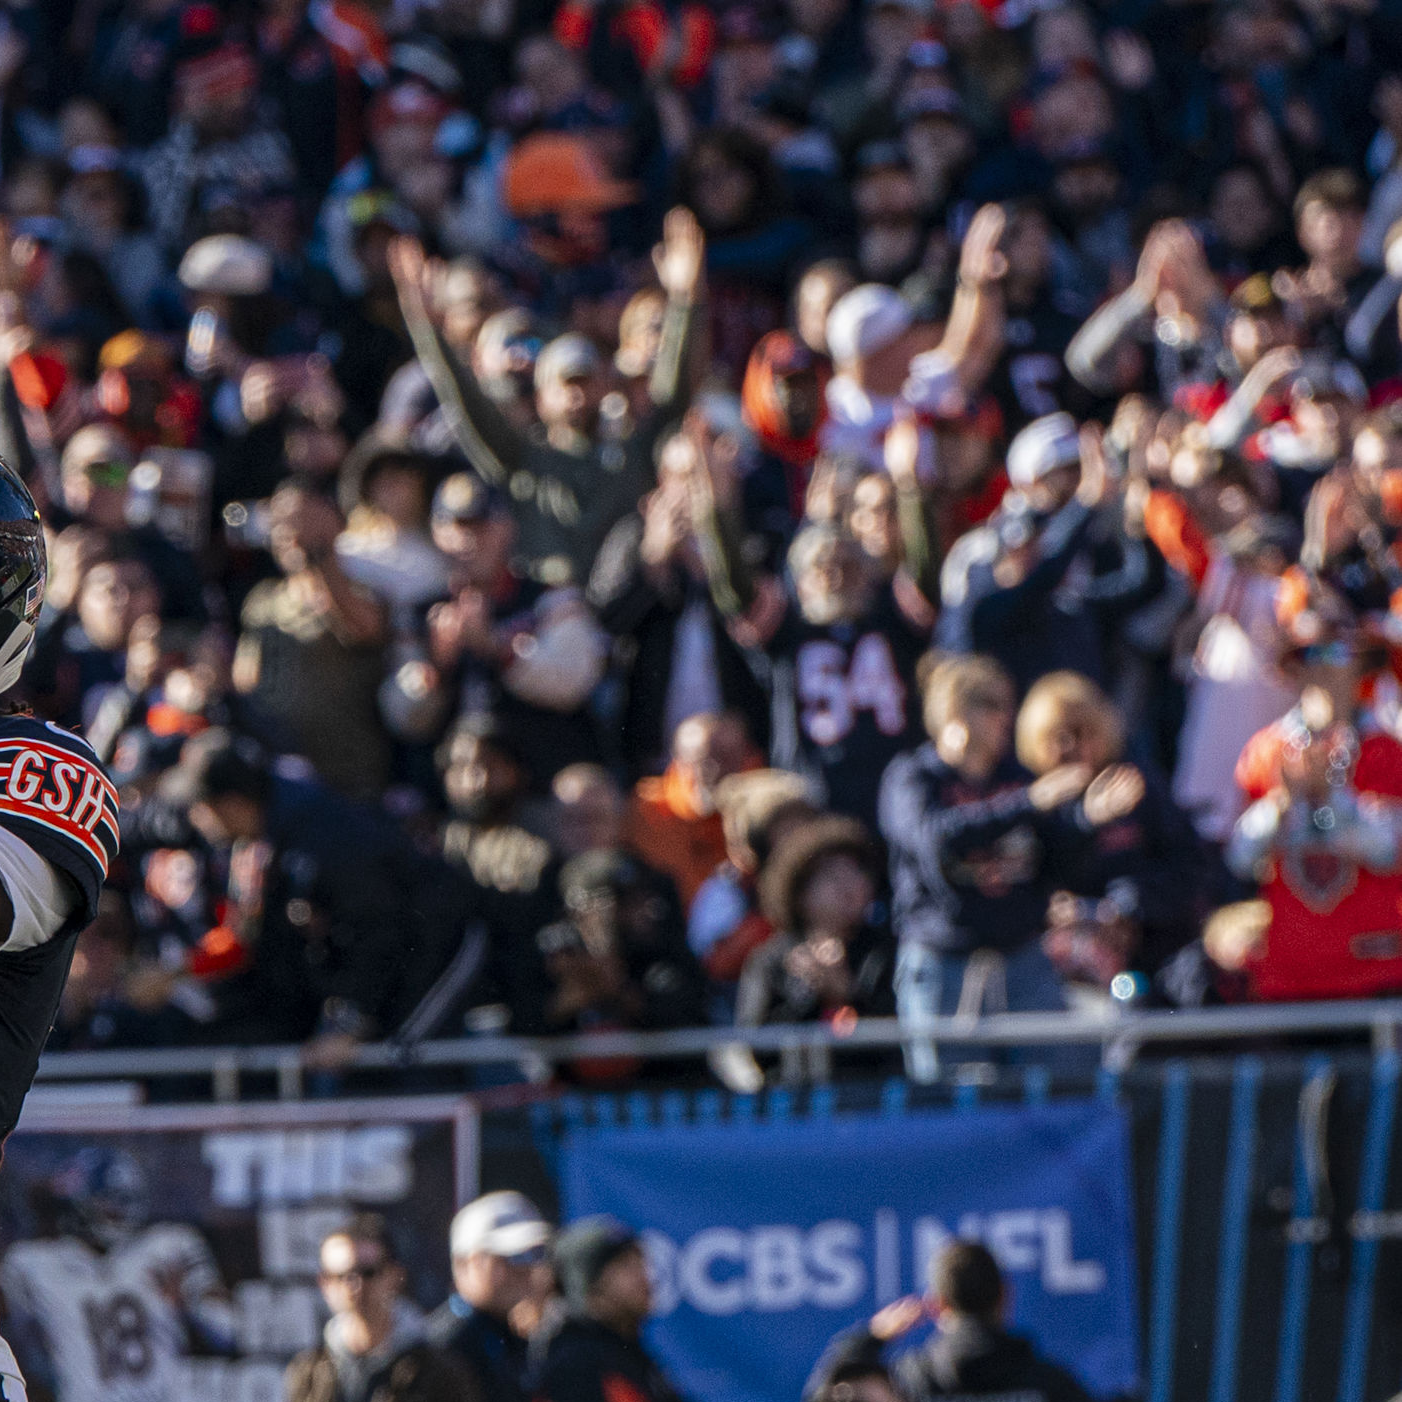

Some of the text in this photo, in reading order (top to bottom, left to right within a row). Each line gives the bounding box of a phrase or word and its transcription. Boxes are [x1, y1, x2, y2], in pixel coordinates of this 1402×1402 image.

[797, 631, 908, 746] 54
[7, 749, 105, 832] GSH
[202, 1126, 416, 1208] THIS
[678, 1219, 867, 1318] CBS
